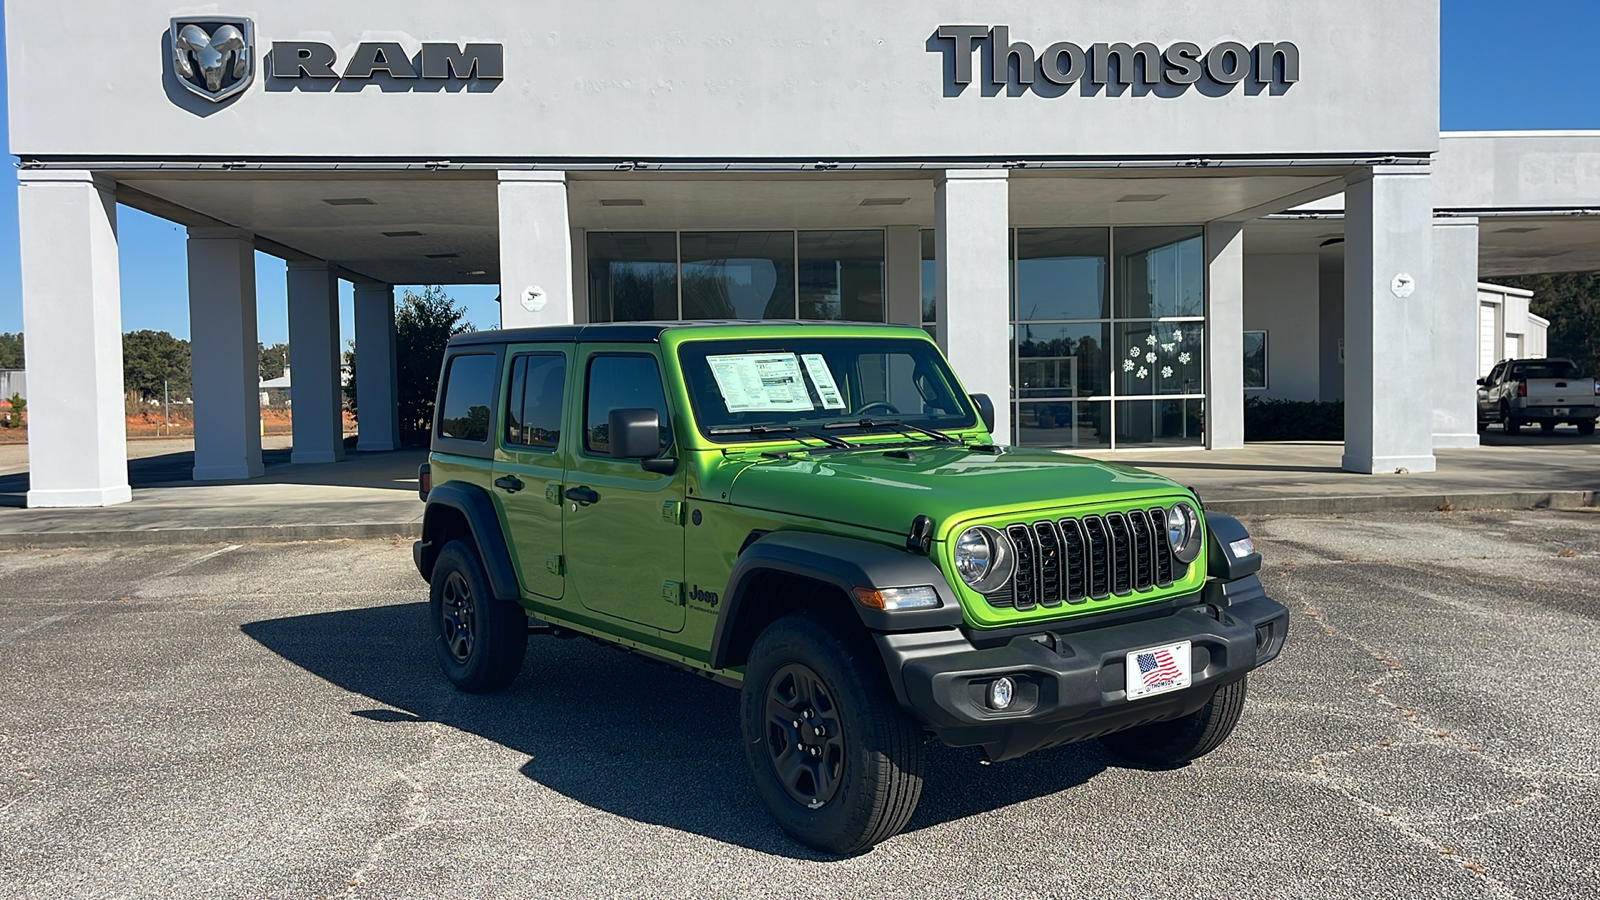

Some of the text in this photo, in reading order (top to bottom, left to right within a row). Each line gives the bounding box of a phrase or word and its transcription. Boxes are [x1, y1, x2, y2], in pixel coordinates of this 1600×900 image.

[271, 41, 504, 79] RAM
[937, 25, 1299, 84] Thomson
[689, 584, 719, 607] Jeep
[1151, 680, 1174, 689] THOMSON
